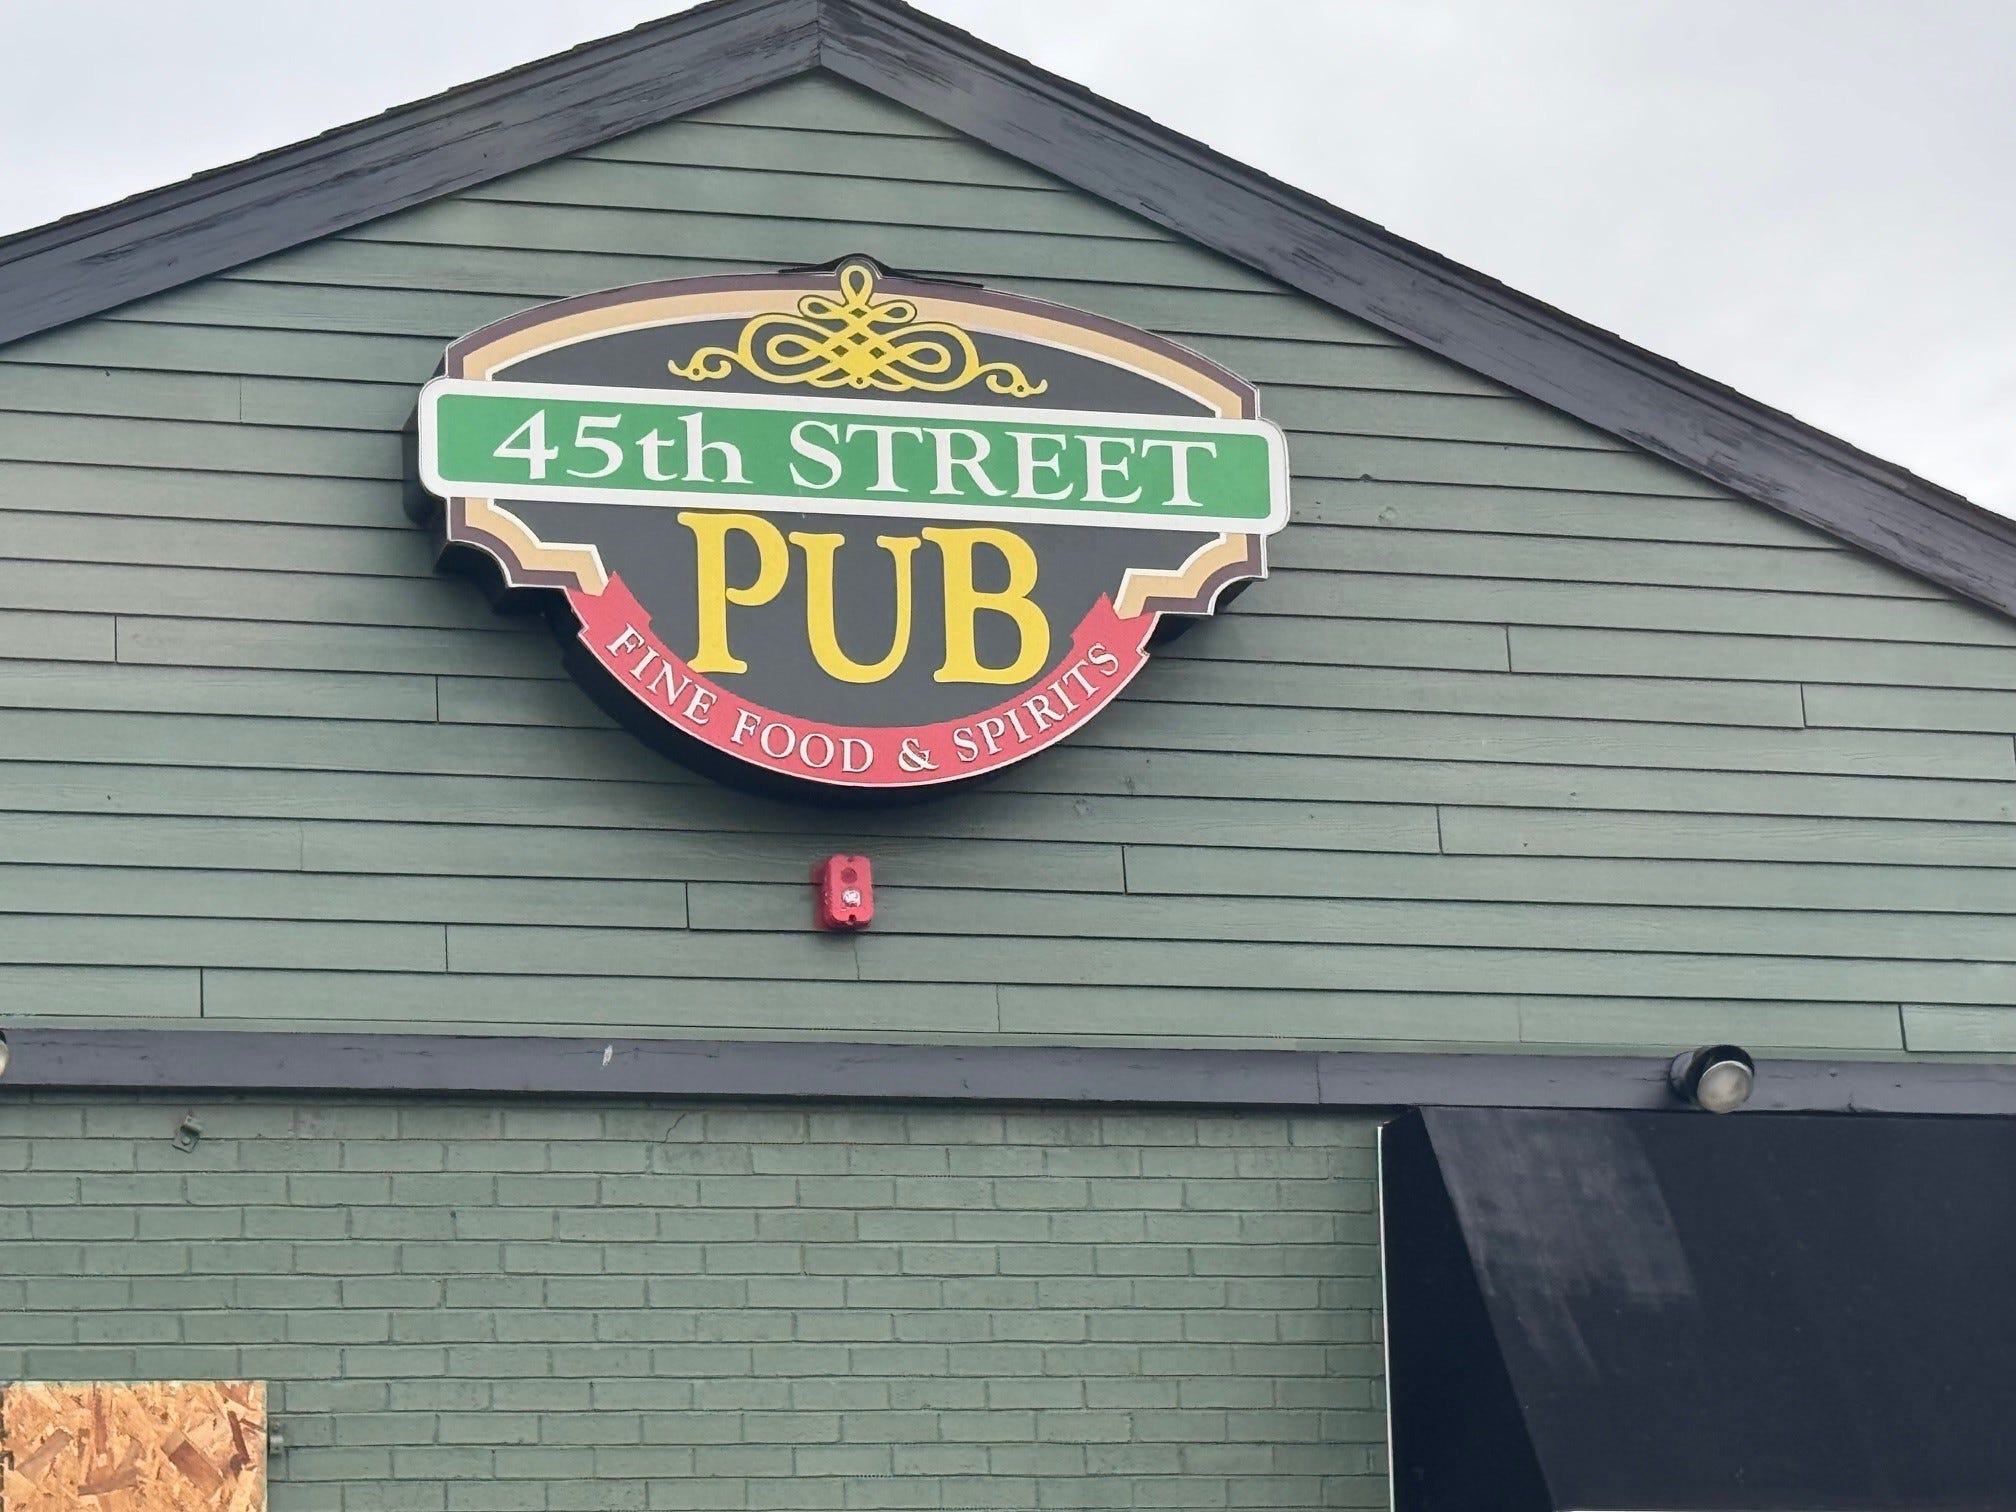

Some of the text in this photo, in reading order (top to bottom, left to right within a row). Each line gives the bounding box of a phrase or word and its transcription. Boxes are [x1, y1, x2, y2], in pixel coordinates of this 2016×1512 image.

[493, 409, 1218, 507] 45th STREET
[678, 512, 1050, 684] PUB
[606, 623, 1121, 774] FINE FOOD & SPIRITS
